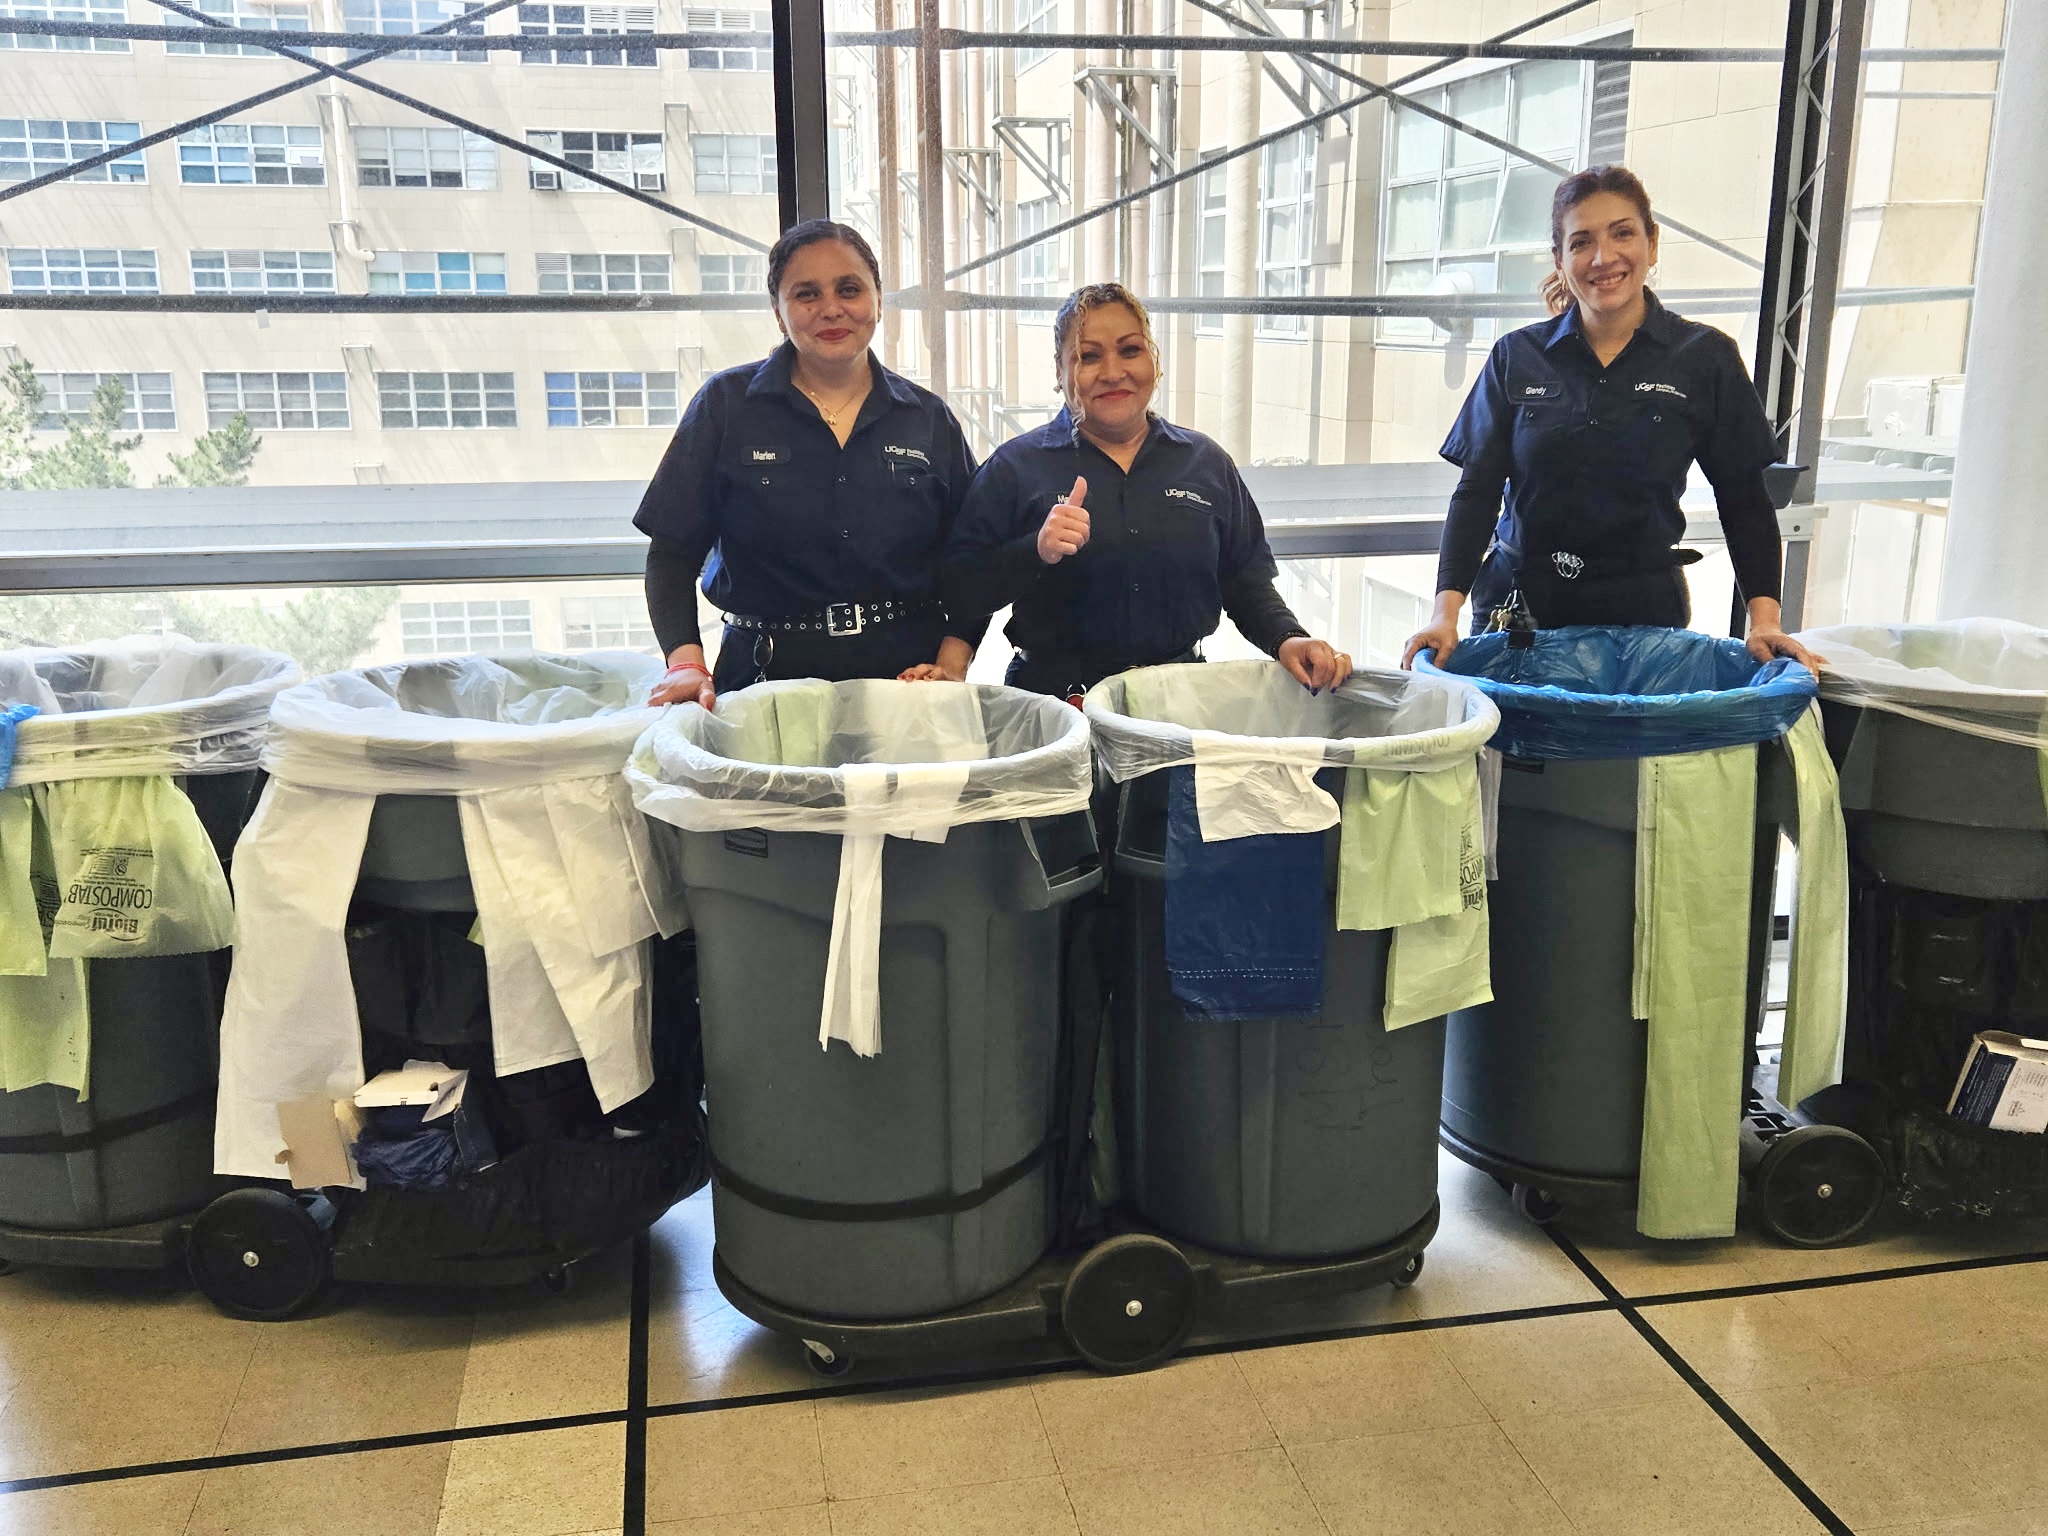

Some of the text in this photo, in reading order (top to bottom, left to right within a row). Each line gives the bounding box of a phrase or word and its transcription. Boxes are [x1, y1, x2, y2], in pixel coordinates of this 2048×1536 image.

[1634, 382, 1656, 391] UCSF
[884, 445, 906, 456] UCSF
[1165, 488, 1186, 498] UCSF
[63, 883, 153, 909] COMPOSTAB
